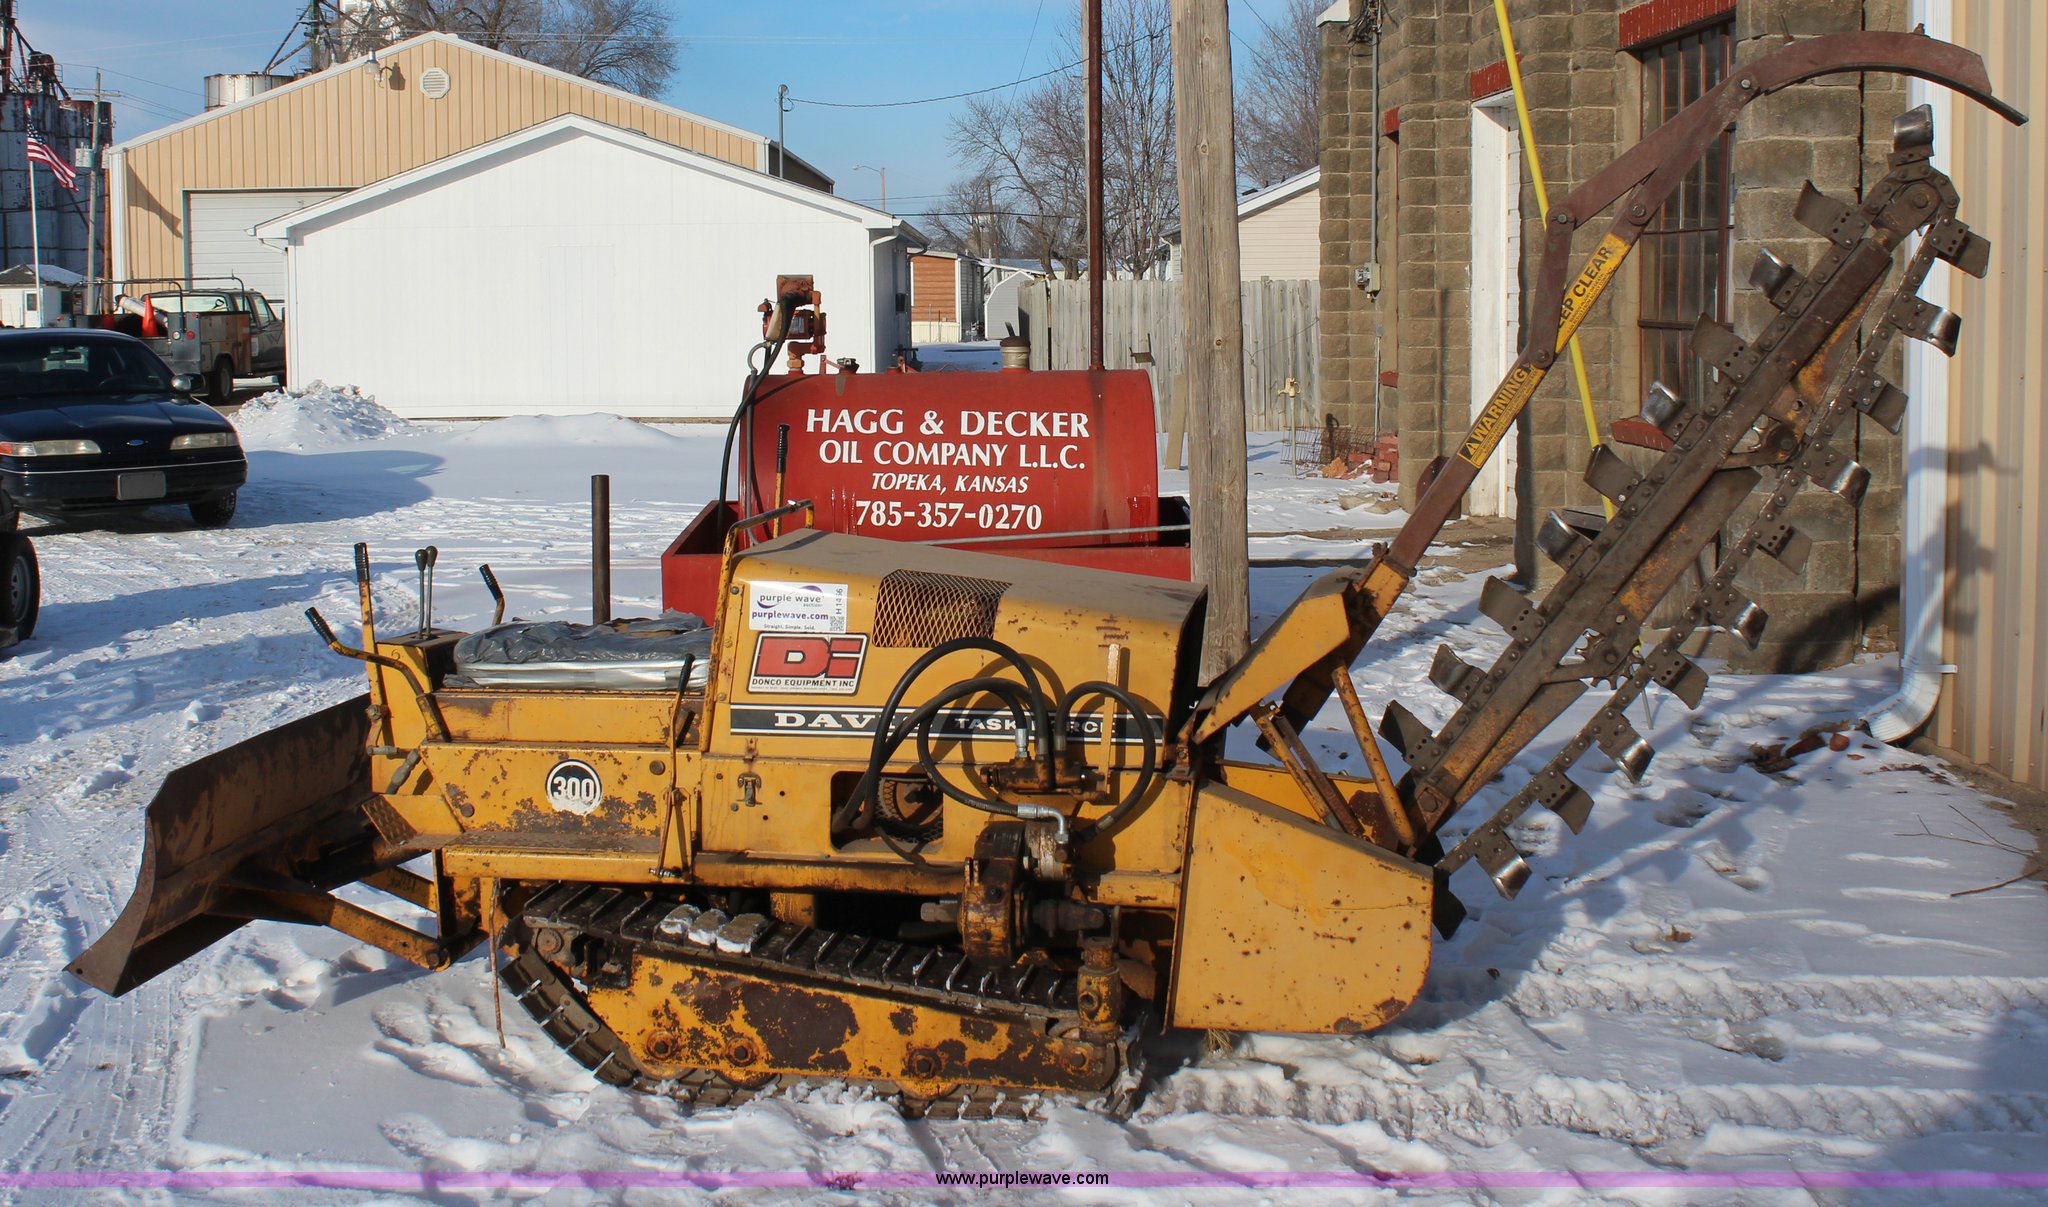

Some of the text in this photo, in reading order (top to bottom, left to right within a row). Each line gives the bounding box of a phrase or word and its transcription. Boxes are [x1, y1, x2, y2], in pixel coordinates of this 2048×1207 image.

[1573, 246, 1611, 298] CLEAR
[1471, 368, 1528, 442] WARNING
[806, 408, 1090, 438] HAGG & DECKER
[819, 439, 1086, 469] OIL COMPANY L.L.C.
[871, 472, 1029, 496] TOPEKA, KANSAS
[855, 500, 1042, 530] 785-357-0270
[760, 593, 821, 603] purple wave
[752, 610, 829, 620] purplewave.com
[752, 678, 782, 686] DONCO
[784, 679, 837, 687] EQUIPMENT
[774, 712, 932, 730] DAV
[955, 718, 1018, 731] TASK
[553, 776, 594, 802] 300
